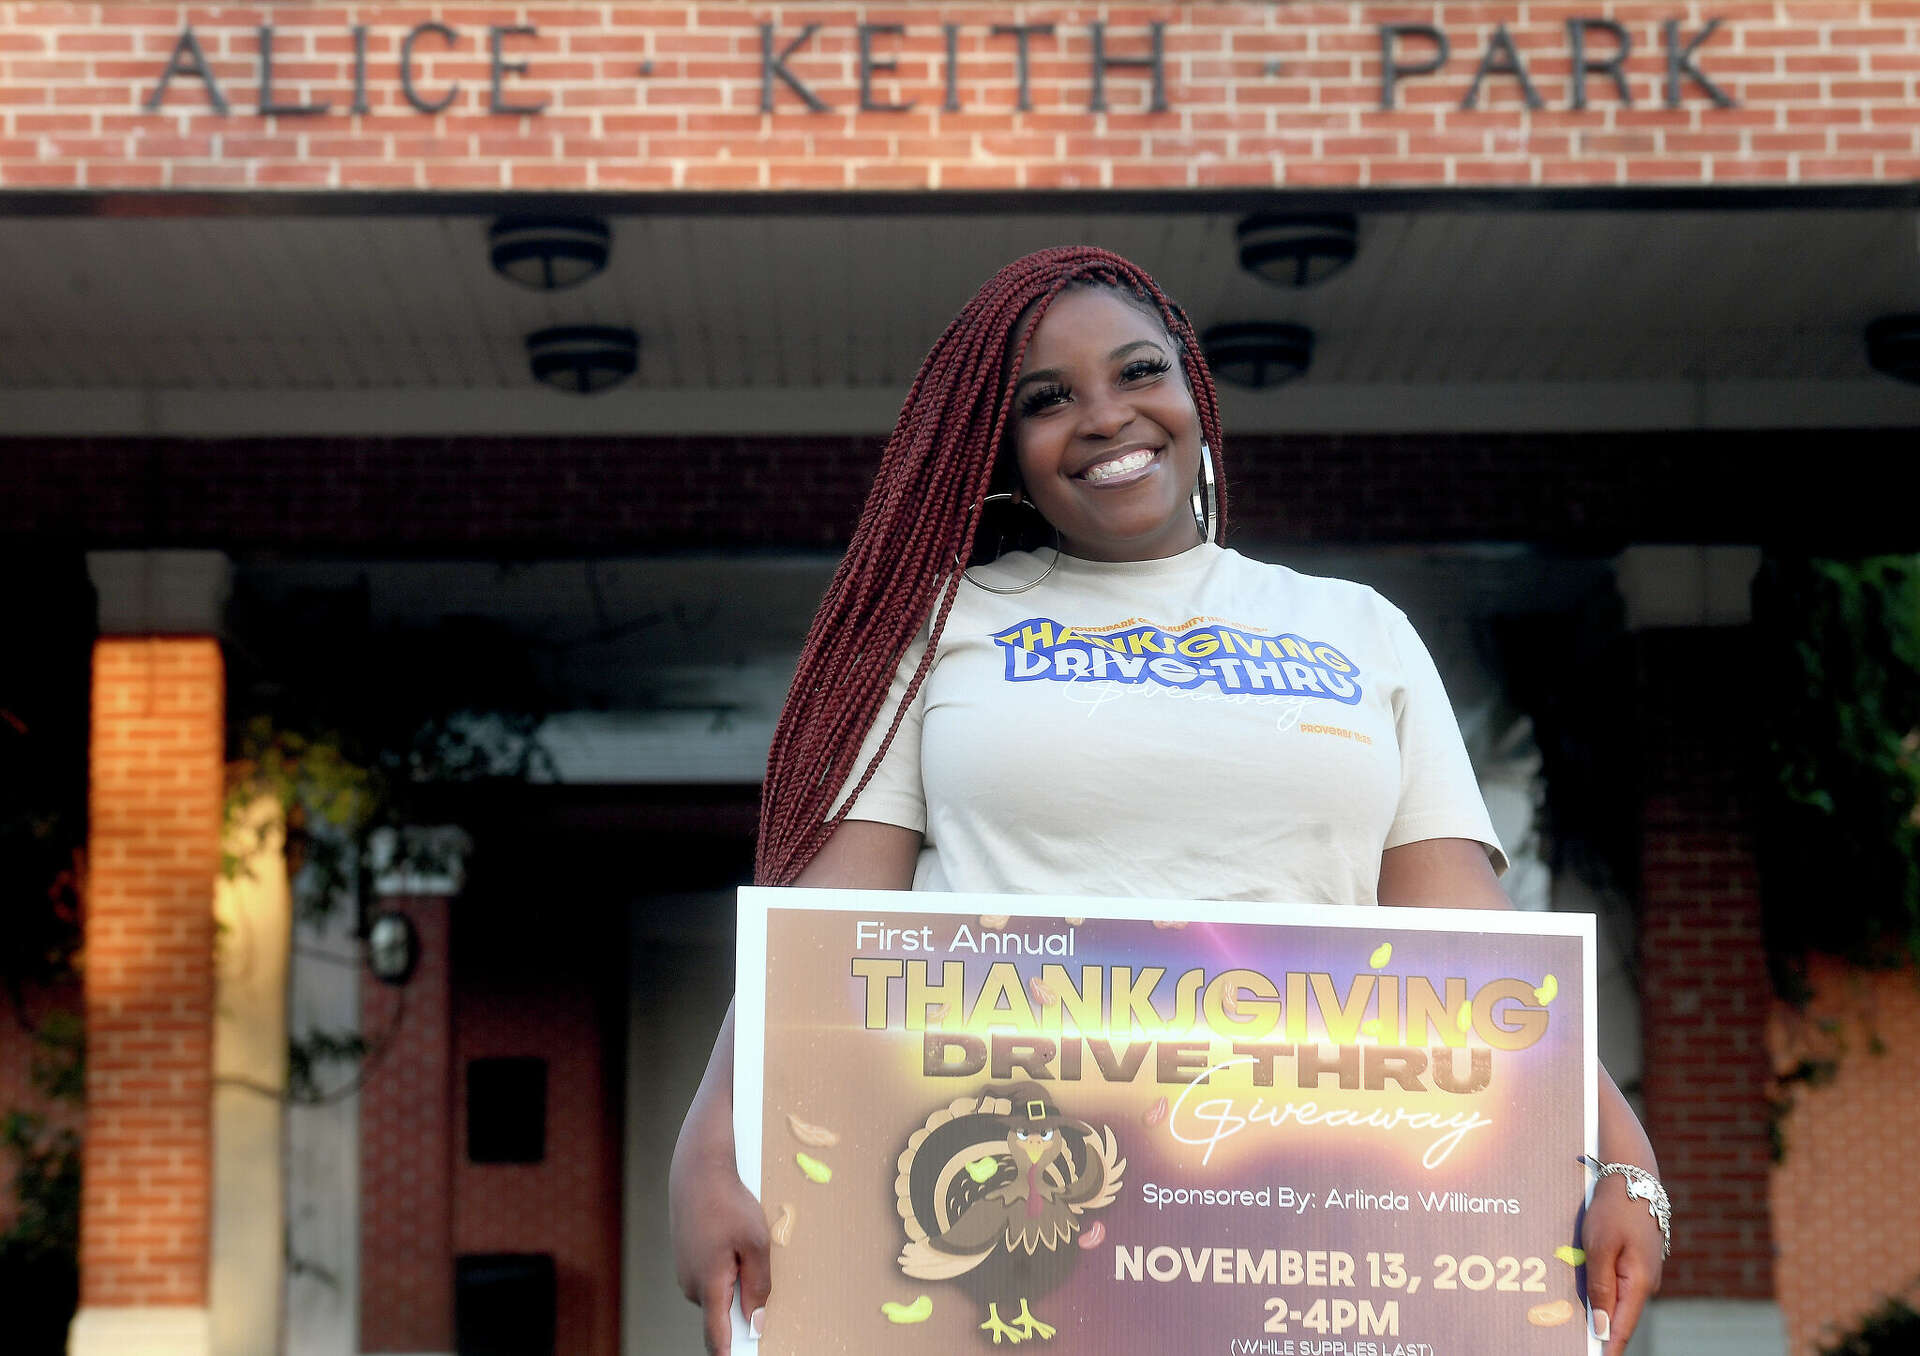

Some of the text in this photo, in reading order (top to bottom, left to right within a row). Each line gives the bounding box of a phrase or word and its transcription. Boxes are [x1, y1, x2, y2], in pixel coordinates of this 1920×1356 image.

[142, 18, 1738, 118] ALICE KEITH PARK
[996, 621, 1352, 673] THANKSGIVING
[1063, 655, 1314, 731] Giveaway
[855, 921, 1076, 957] First Annual
[851, 958, 1551, 1051] THANKSGIVING
[1169, 1058, 1492, 1170] Giveaway
[1142, 1183, 1521, 1215] Sponsored By: Arlinda Williams
[1114, 1245, 1547, 1294] NOVEMBER 13, 2022
[1263, 1297, 1400, 1336] 2-4PM
[1230, 1338, 1434, 1356] (WHILE SUPPLIES LAST)
